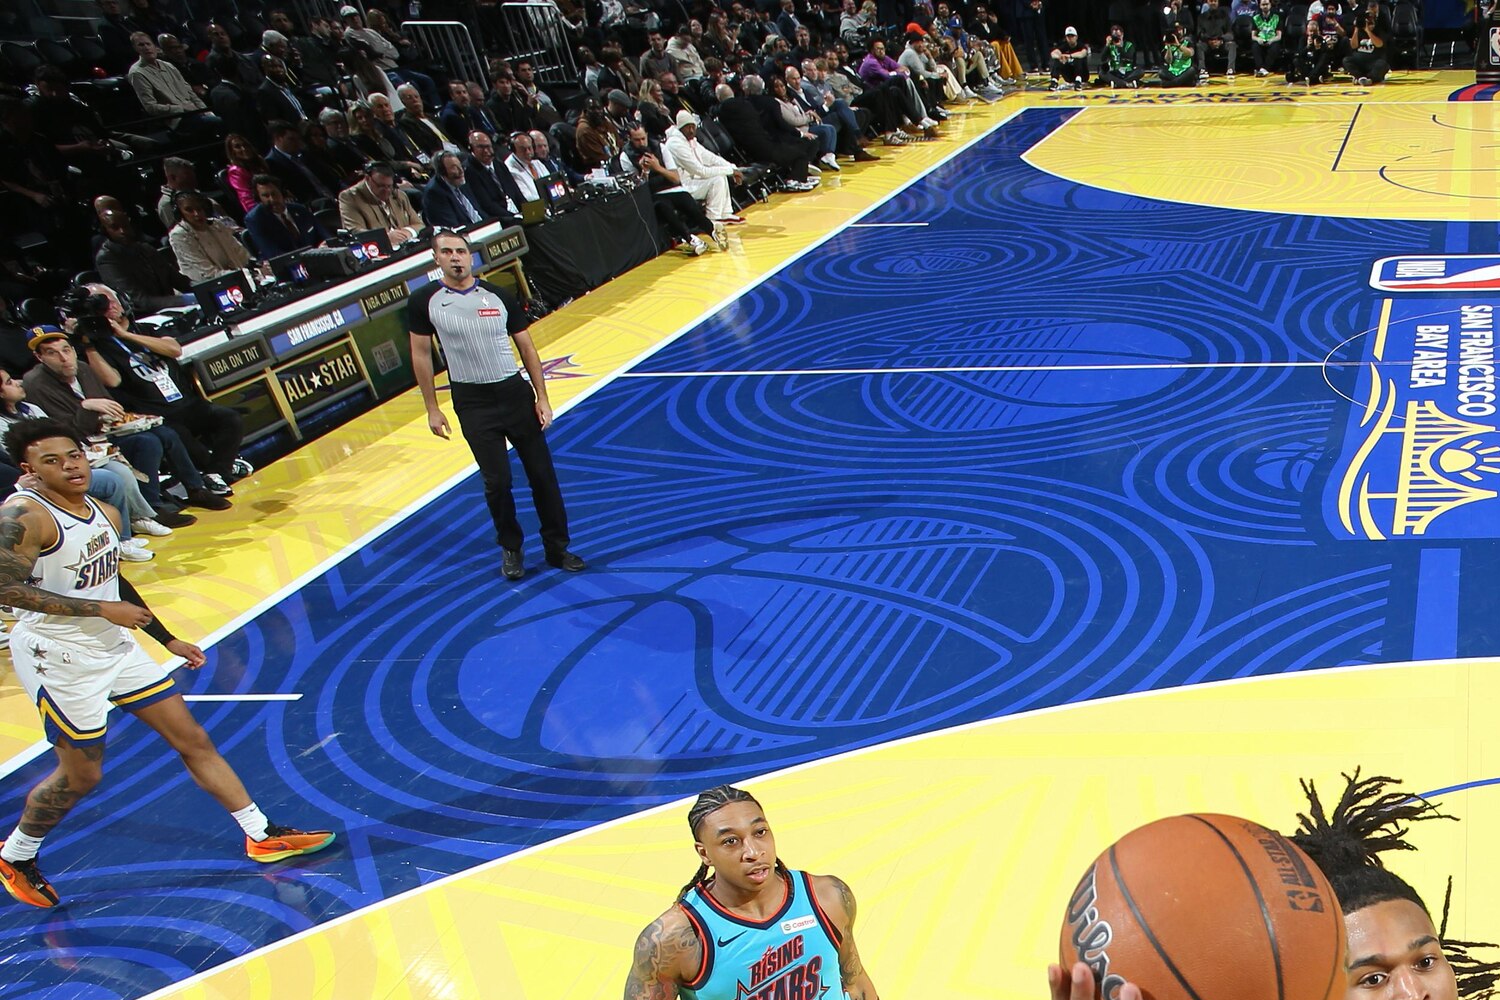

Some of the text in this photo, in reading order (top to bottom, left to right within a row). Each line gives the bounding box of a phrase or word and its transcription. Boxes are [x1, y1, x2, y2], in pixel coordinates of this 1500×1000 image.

[1395, 260, 1446, 278] NBA
[365, 285, 404, 311] NBA ON TNT
[286, 326, 302, 346] SAN
[209, 346, 260, 377] NBA ON TNT
[1409, 324, 1450, 389] BAY AREA
[1457, 304, 1497, 417] SAN FRANCISCO
[86, 530, 110, 558] RISING
[75, 547, 119, 590] STARS
[792, 918, 816, 929] Castrol
[749, 934, 804, 989] RISING
